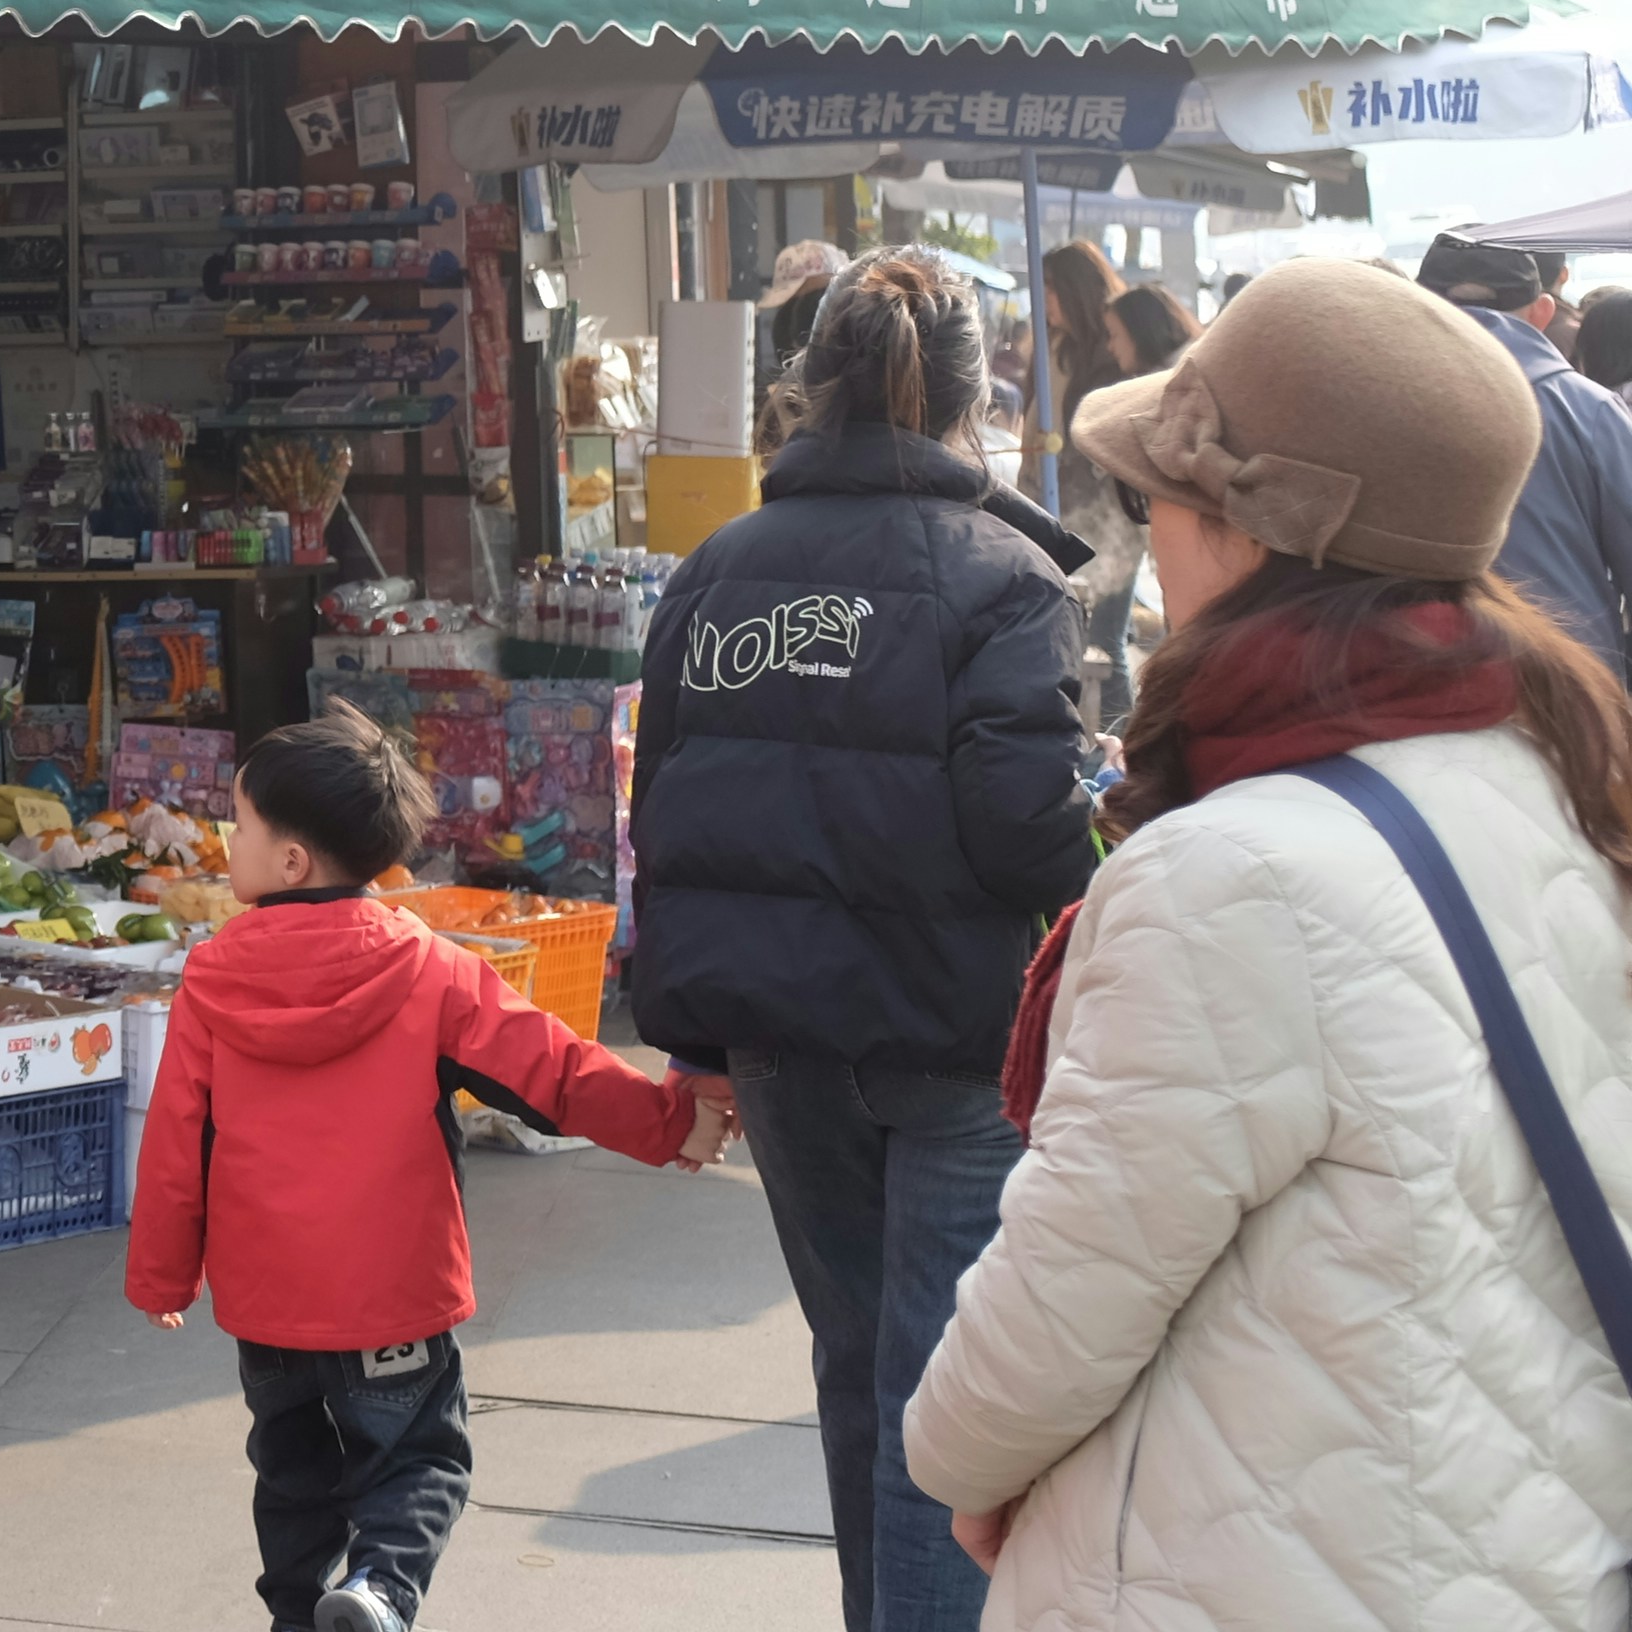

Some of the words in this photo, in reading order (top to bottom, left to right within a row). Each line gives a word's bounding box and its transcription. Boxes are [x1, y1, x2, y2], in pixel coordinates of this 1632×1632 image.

[749, 89, 1128, 143] 快速补充电解质
[1347, 78, 1481, 128] 补水啦
